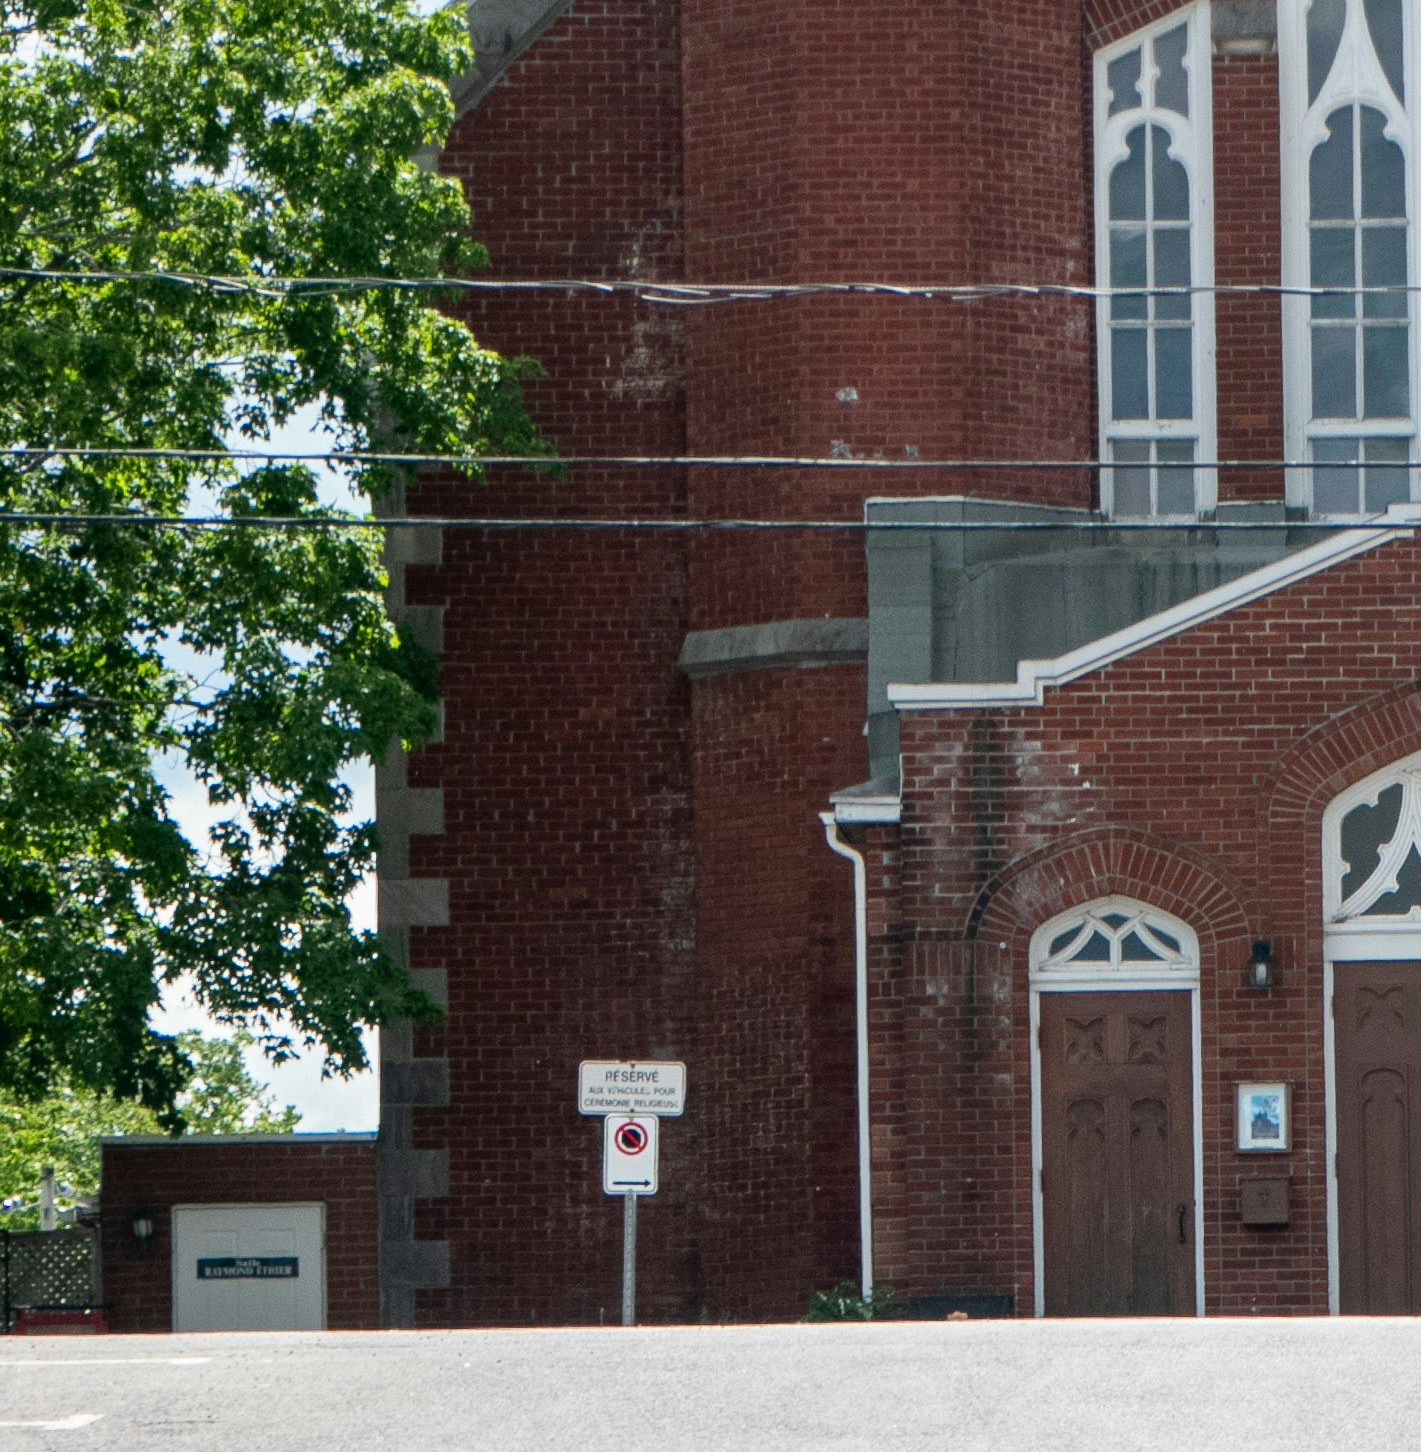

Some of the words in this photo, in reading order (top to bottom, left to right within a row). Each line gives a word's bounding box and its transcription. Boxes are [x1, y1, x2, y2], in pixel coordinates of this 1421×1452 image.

[605, 1069, 659, 1083] RÉSERVÉ
[588, 1087, 604, 1095] AUX
[653, 1087, 676, 1096] POUR
[583, 1098, 630, 1108] CÉRÉMONIE
